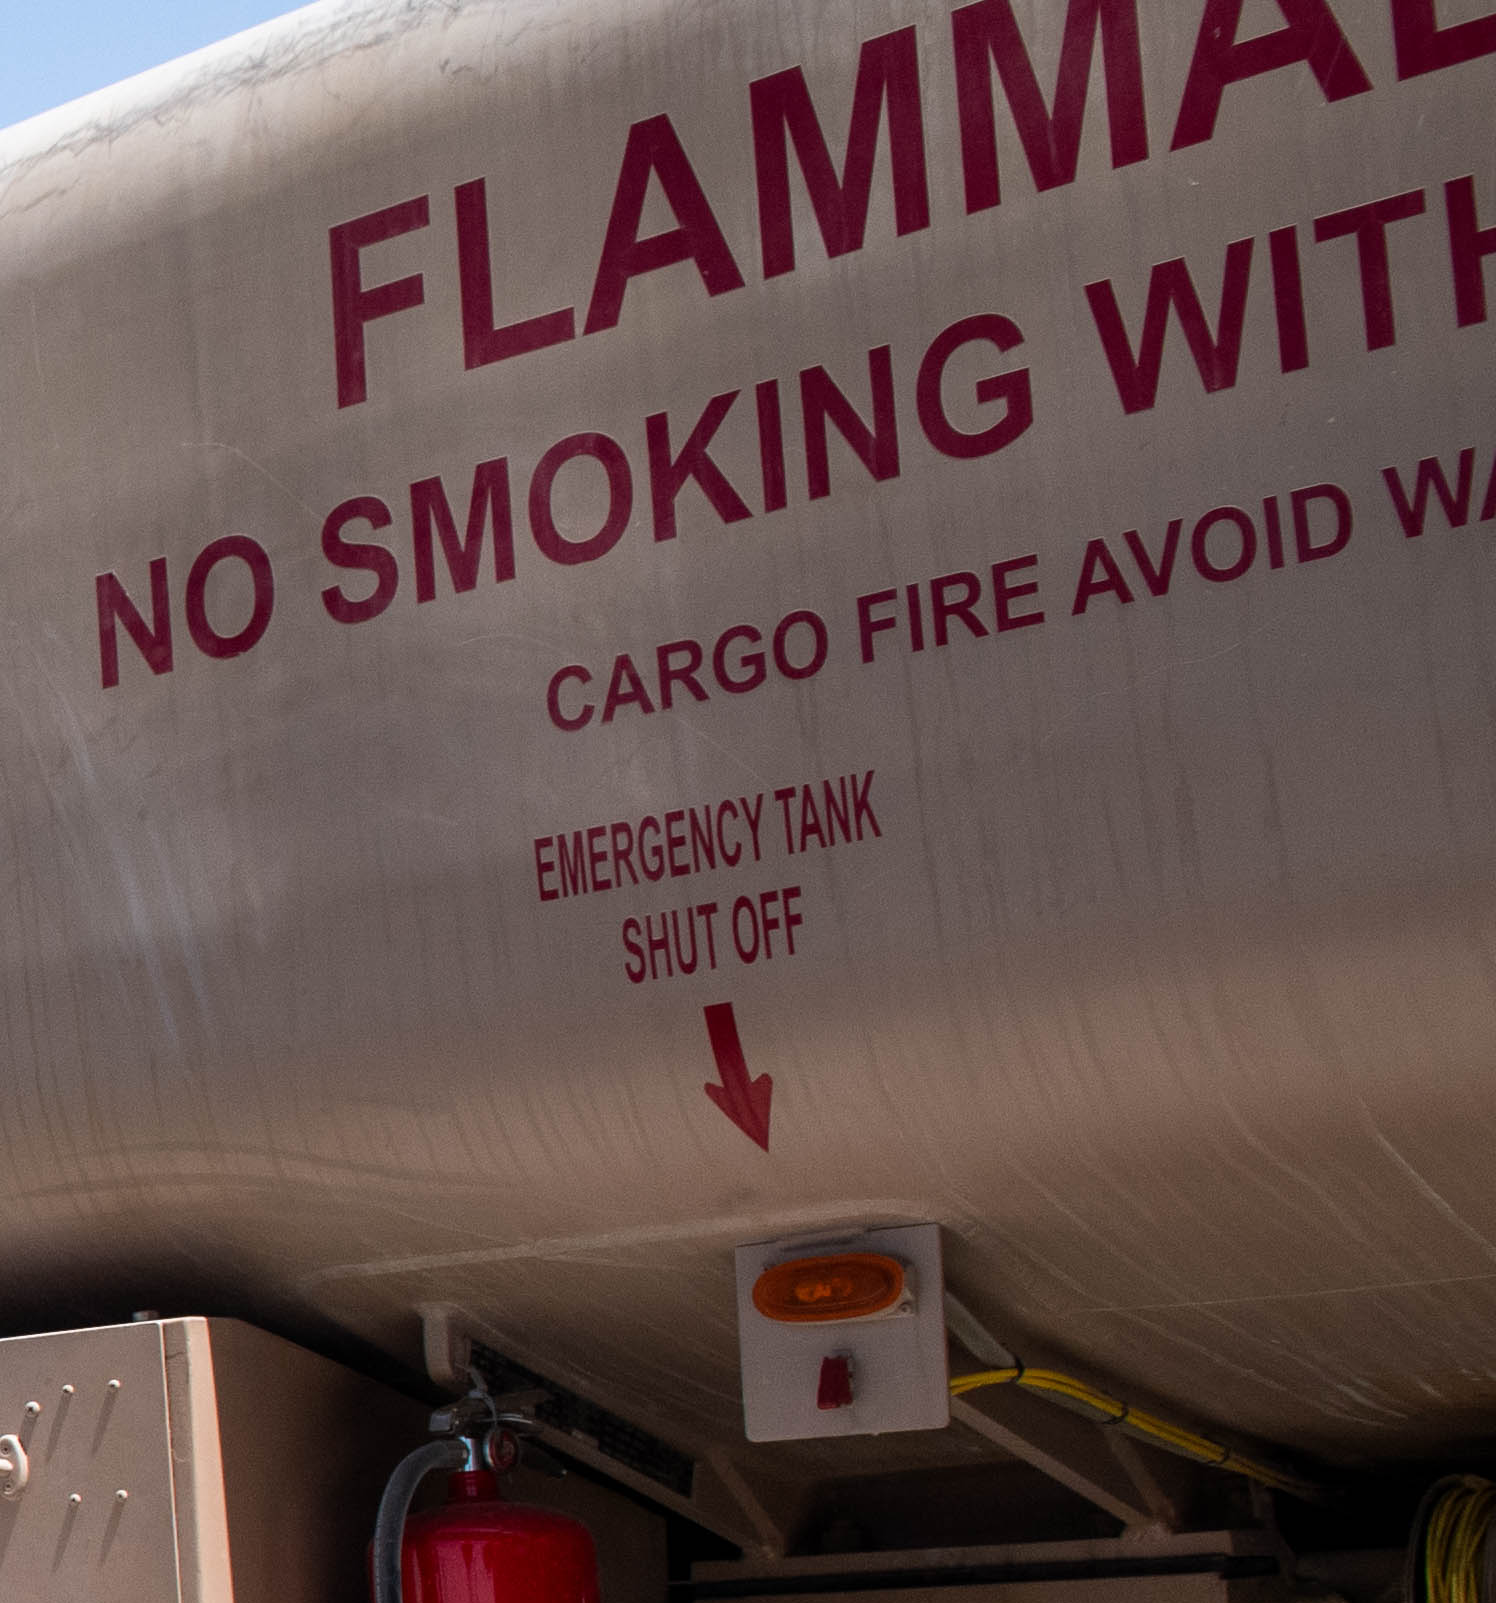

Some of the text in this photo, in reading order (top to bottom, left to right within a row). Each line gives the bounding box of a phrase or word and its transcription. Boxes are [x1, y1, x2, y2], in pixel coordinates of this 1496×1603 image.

[328, 0, 1496, 409] FLAMMA
[95, 535, 273, 689] NO
[321, 313, 1034, 625] SMOKING
[546, 447, 1496, 732] CARGO FIRE AVOID W
[534, 769, 883, 901] EMERGENCY TANK
[622, 886, 804, 985] SHUT OFF
